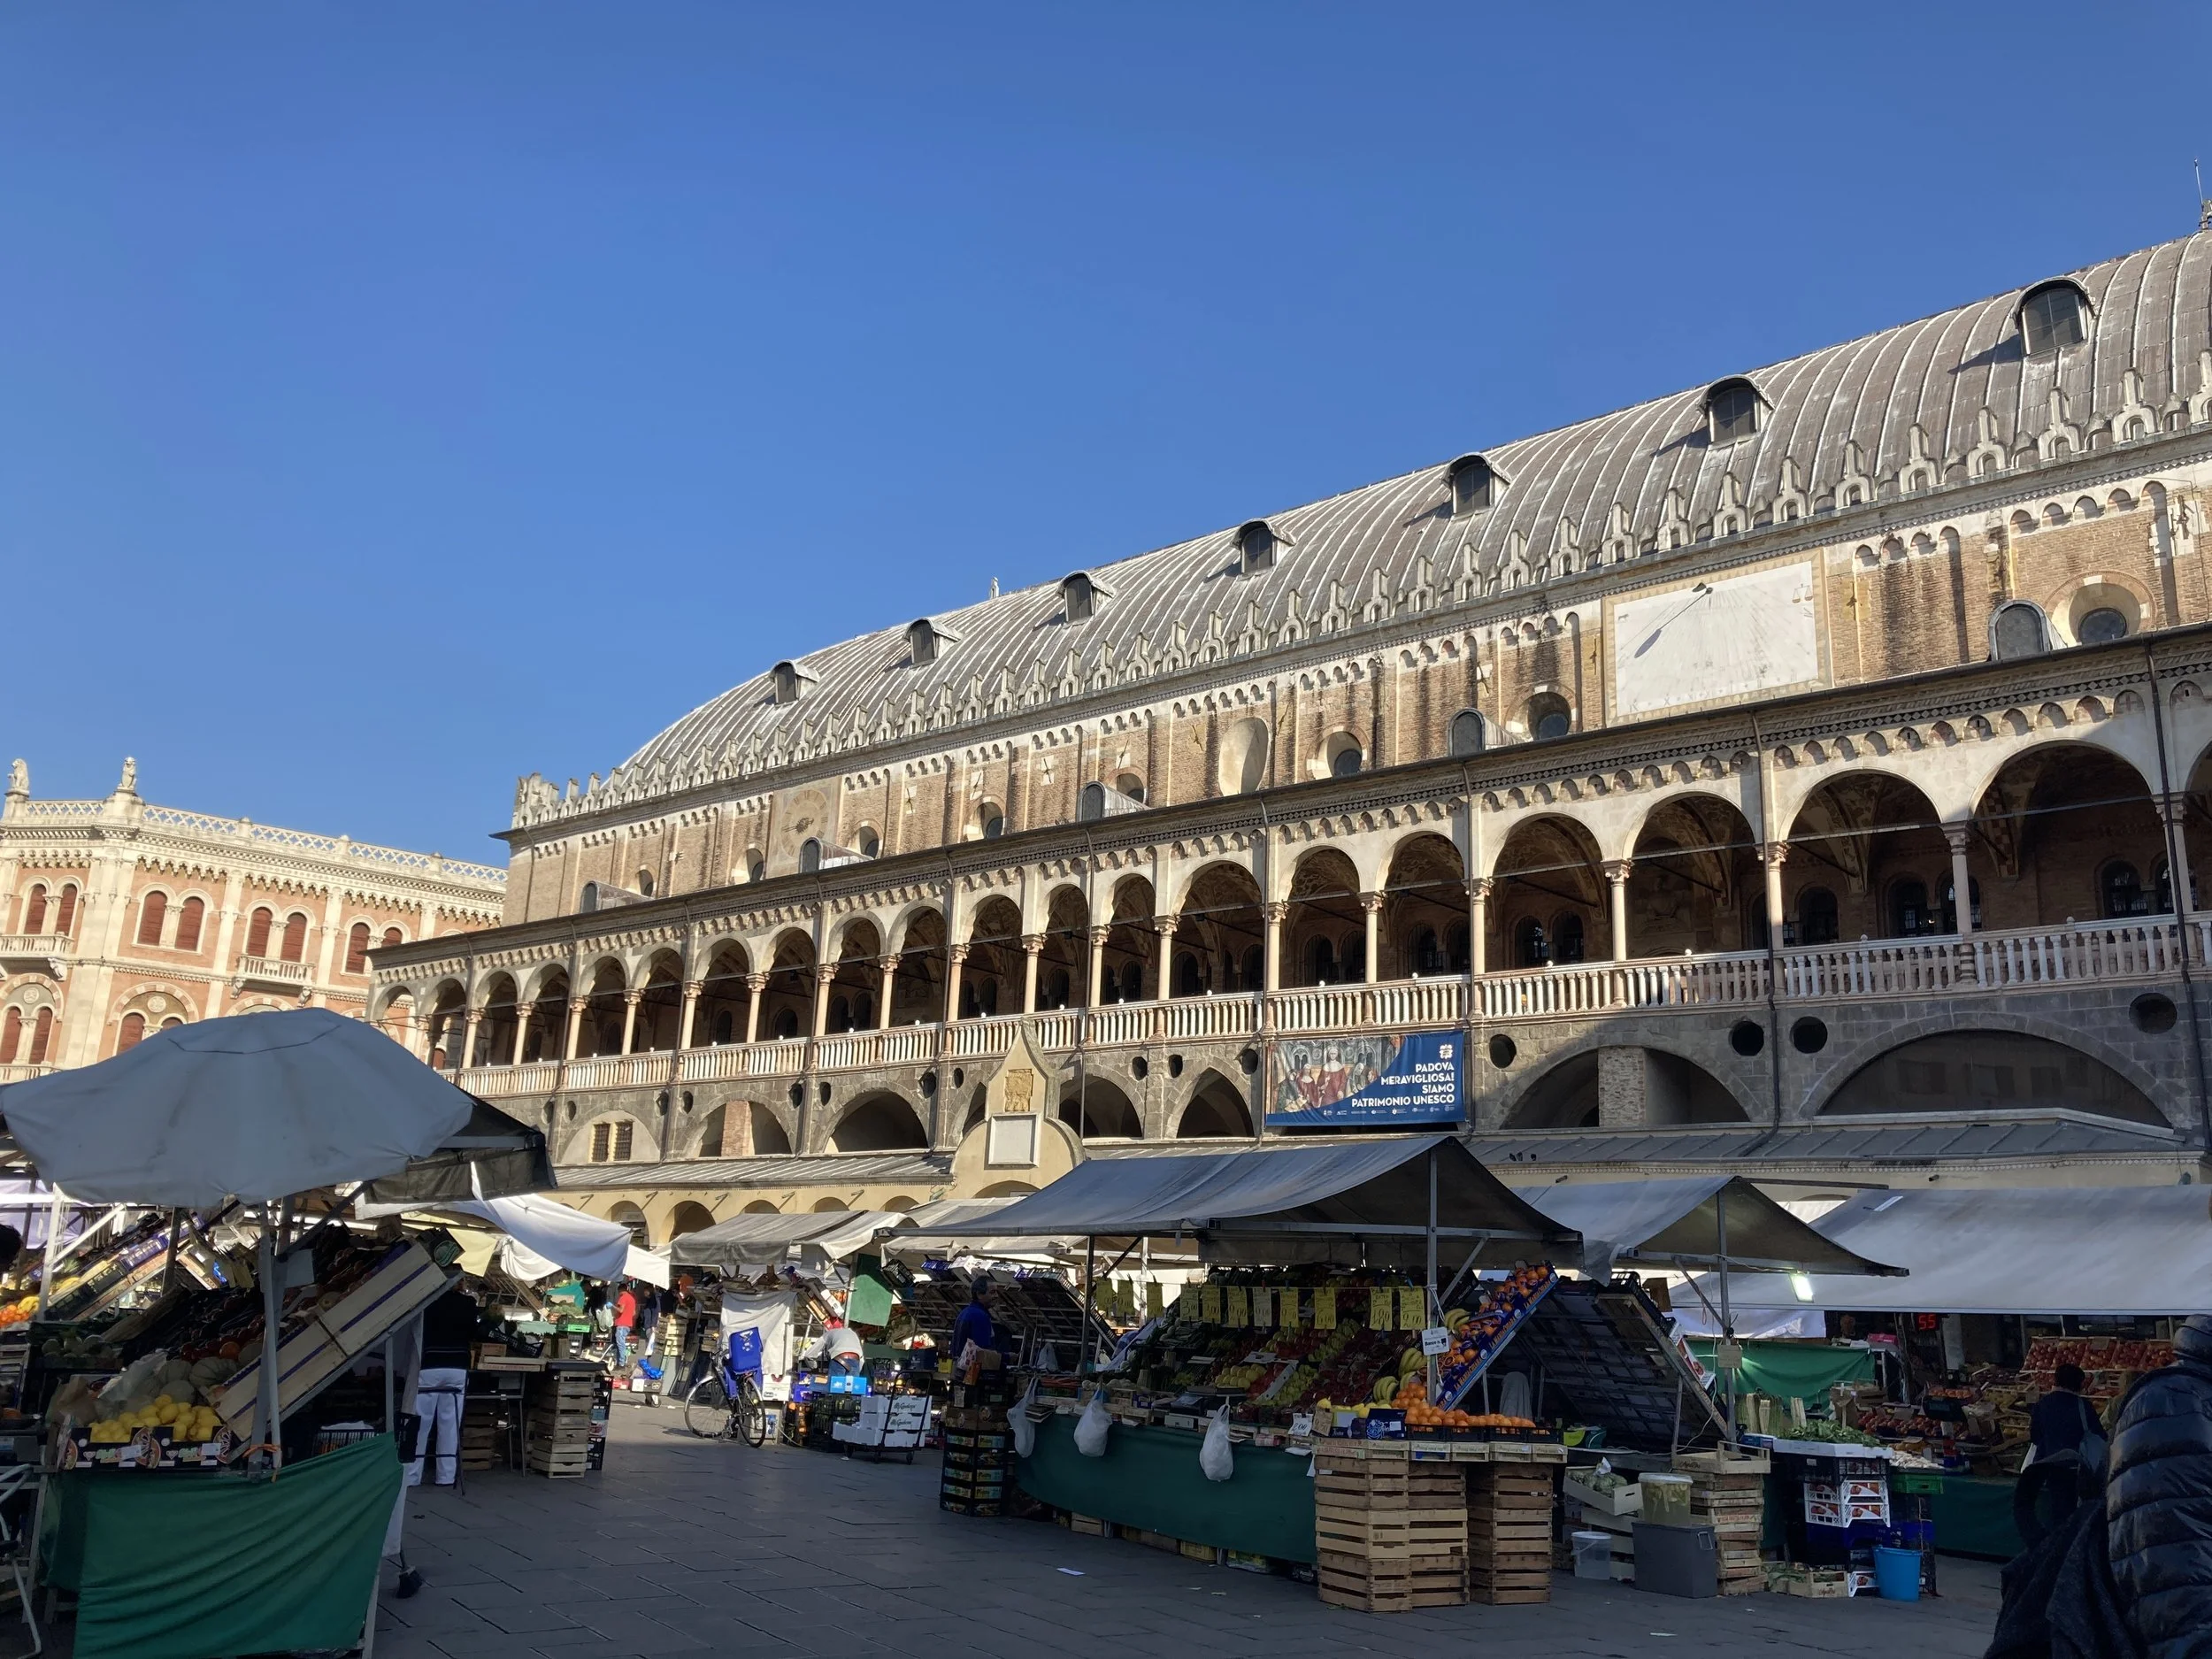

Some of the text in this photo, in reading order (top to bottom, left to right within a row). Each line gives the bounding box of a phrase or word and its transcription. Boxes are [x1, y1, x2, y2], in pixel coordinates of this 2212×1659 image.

[1415, 1062, 1455, 1072] PADOVA
[1380, 1072, 1455, 1086] MERAVIGLIOSA!
[1422, 1083, 1455, 1094] SIAMO
[1351, 1094, 1455, 1108] PATRIMONIO UNESCO
[1918, 1313, 1936, 1331] 55
